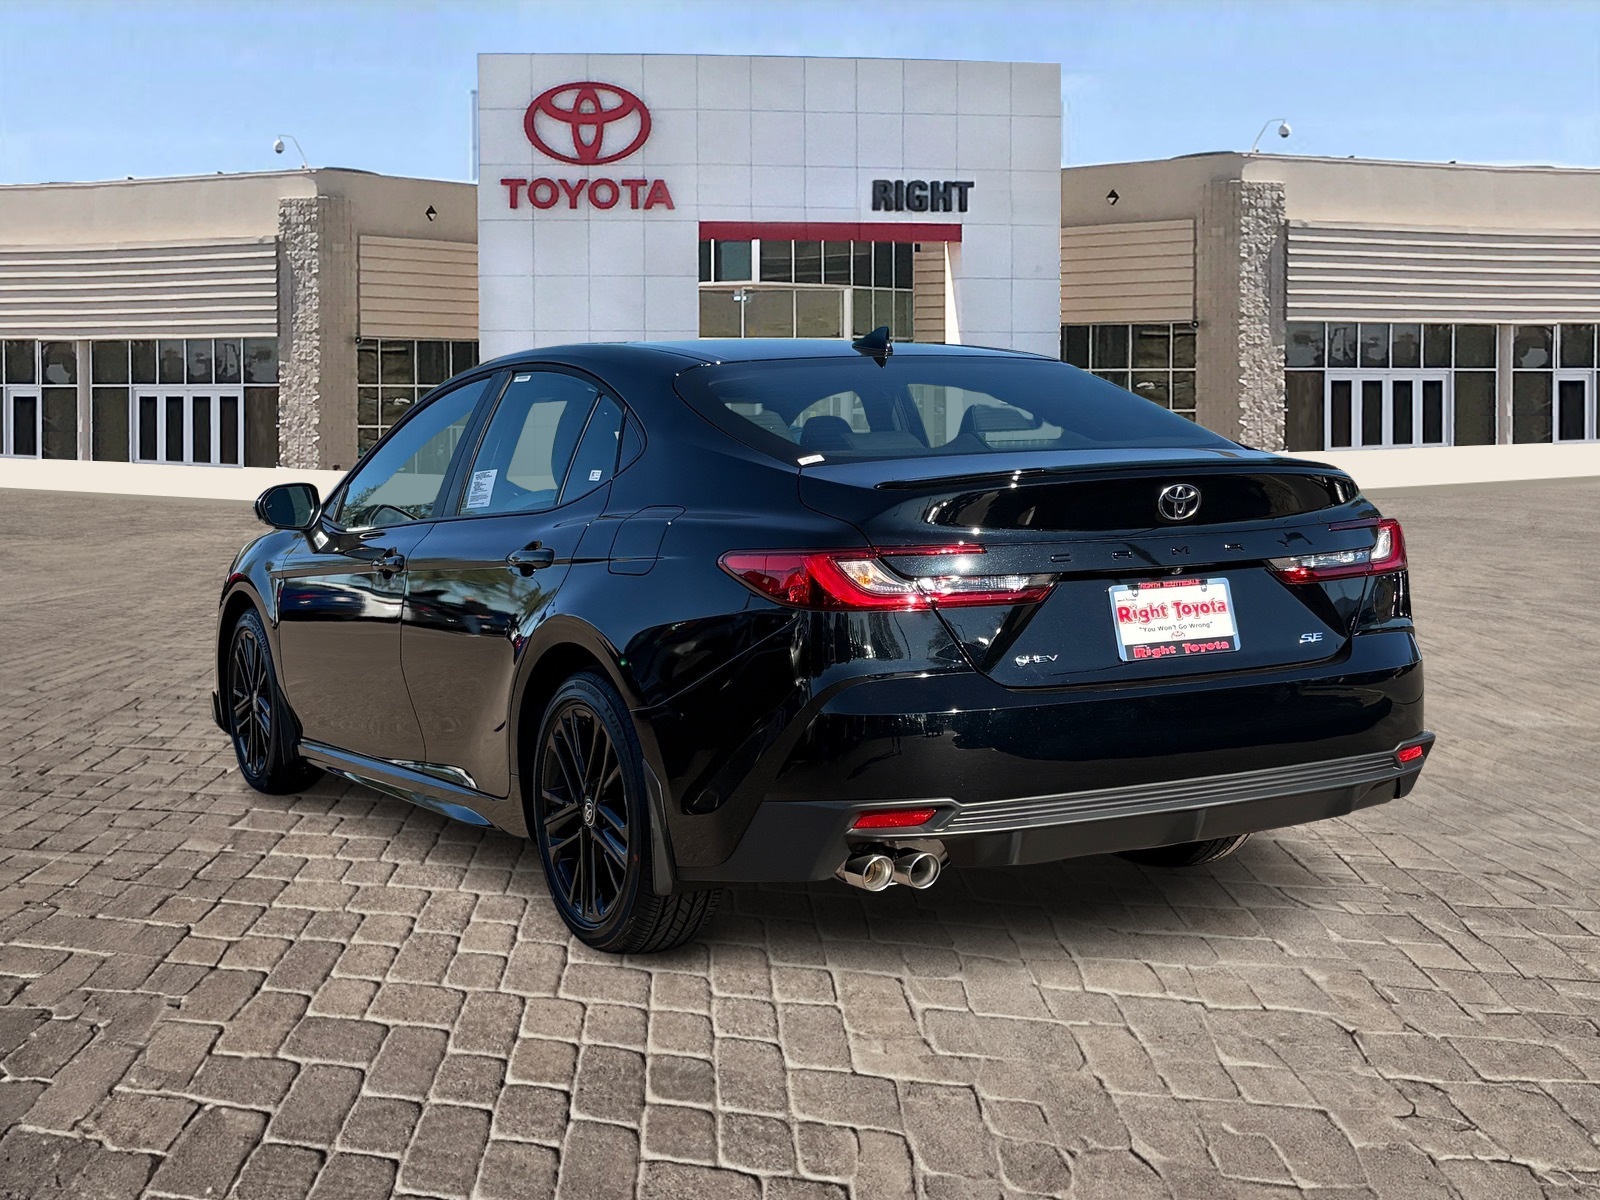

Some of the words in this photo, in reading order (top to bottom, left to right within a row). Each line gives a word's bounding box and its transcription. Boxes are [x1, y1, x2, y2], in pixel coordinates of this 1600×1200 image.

[500, 178, 675, 209] TOYOTA
[872, 180, 975, 212] RIGHT
[1050, 531, 1313, 563] CAMRY
[1117, 602, 1169, 624] Right
[1172, 598, 1228, 620] Toyota
[1133, 645, 1176, 659] Right
[1182, 640, 1229, 654] Toyota
[1299, 632, 1323, 643] SE
